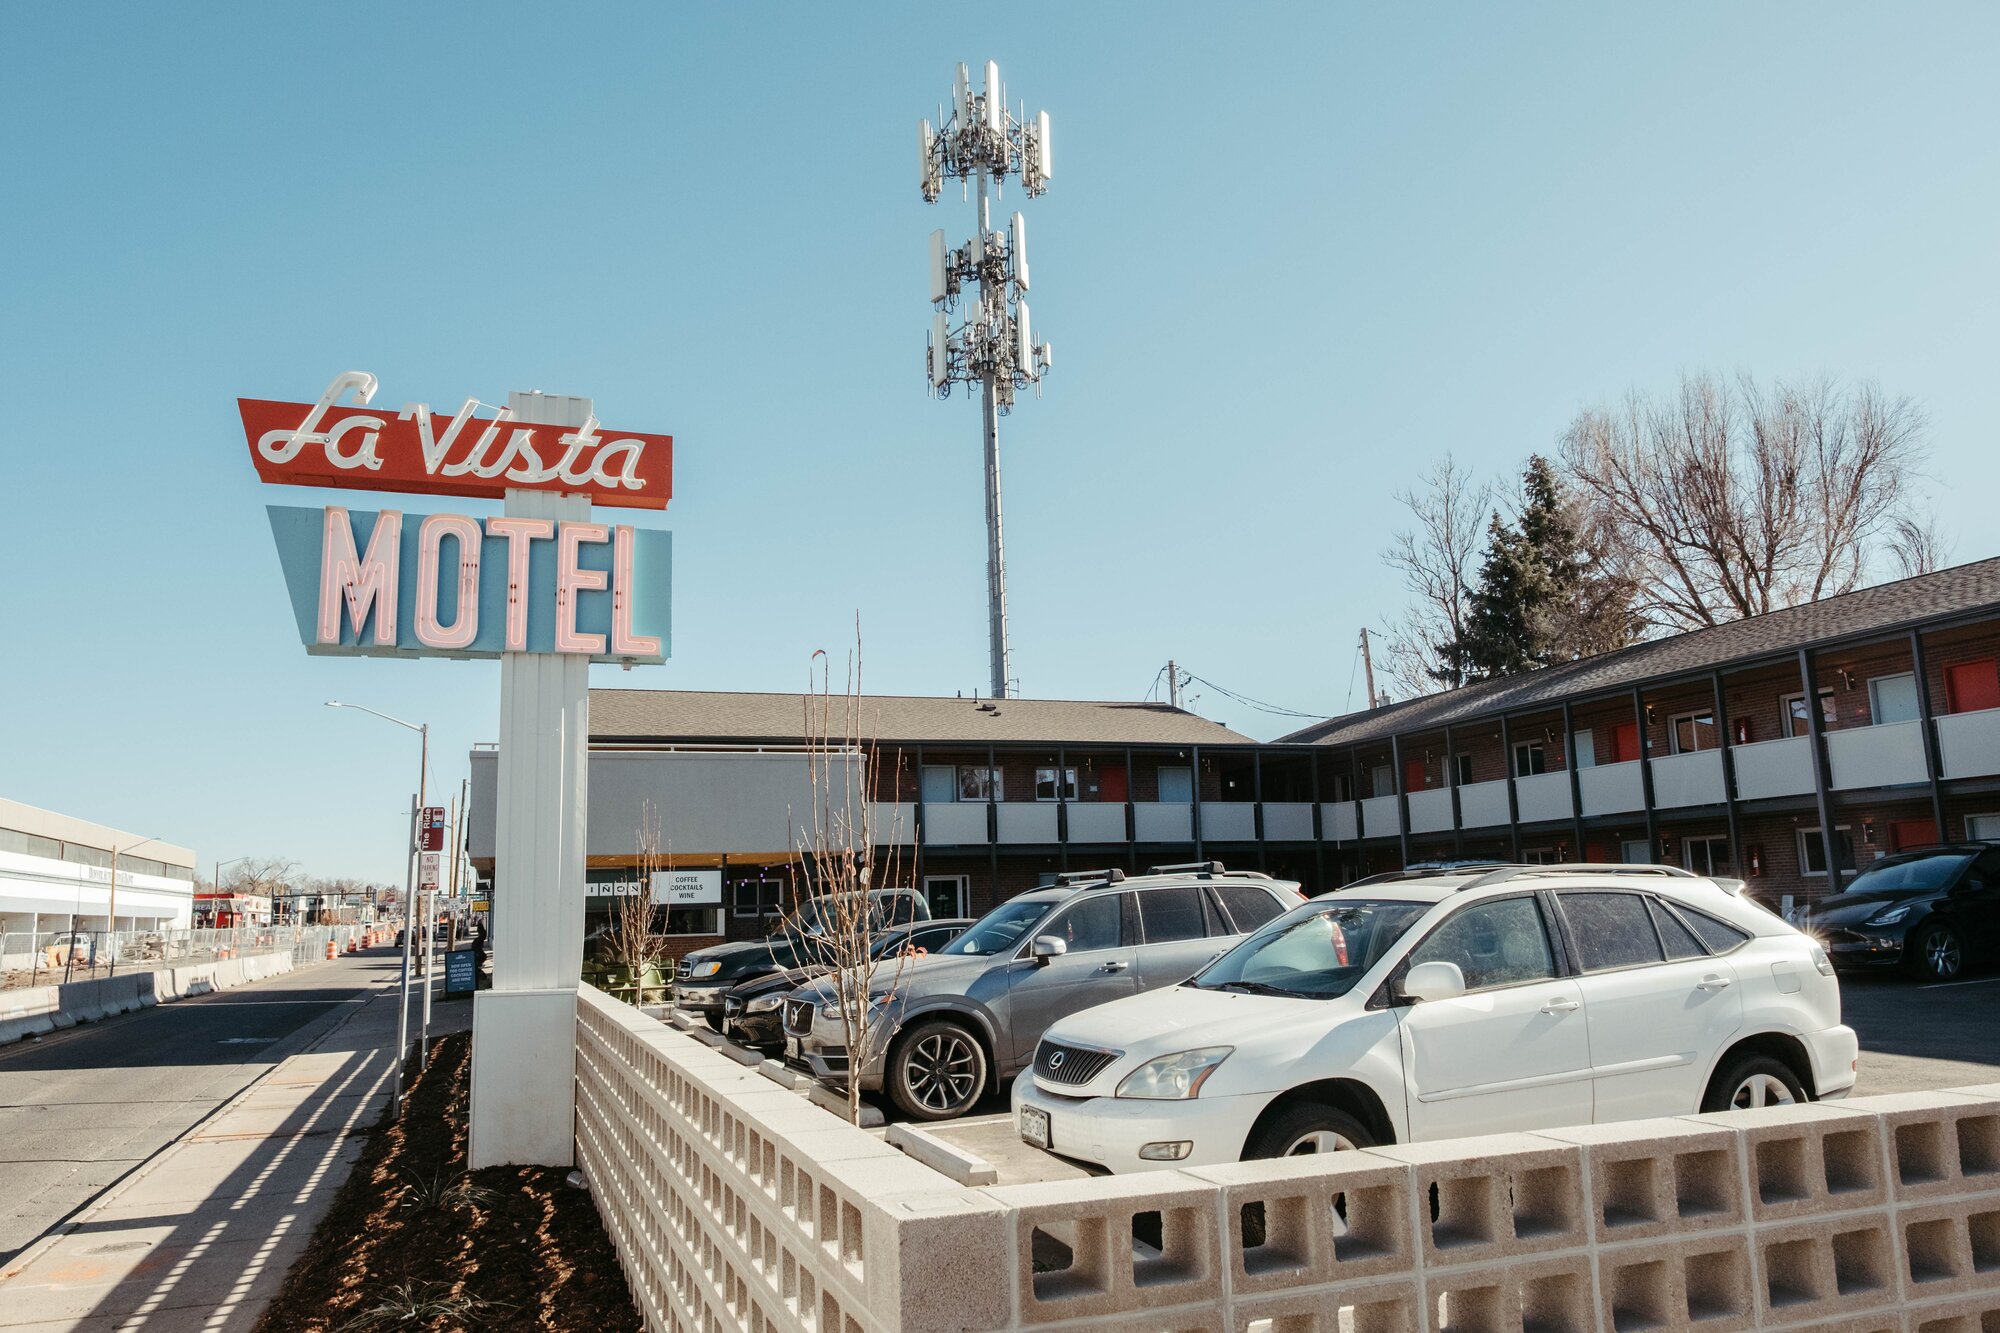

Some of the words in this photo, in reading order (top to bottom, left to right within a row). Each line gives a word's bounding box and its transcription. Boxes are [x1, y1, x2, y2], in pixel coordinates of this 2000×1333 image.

[257, 371, 386, 470] La
[397, 396, 647, 490] Vista
[316, 505, 662, 656] MOTEL
[422, 832, 430, 850] The
[426, 856, 434, 864] NO
